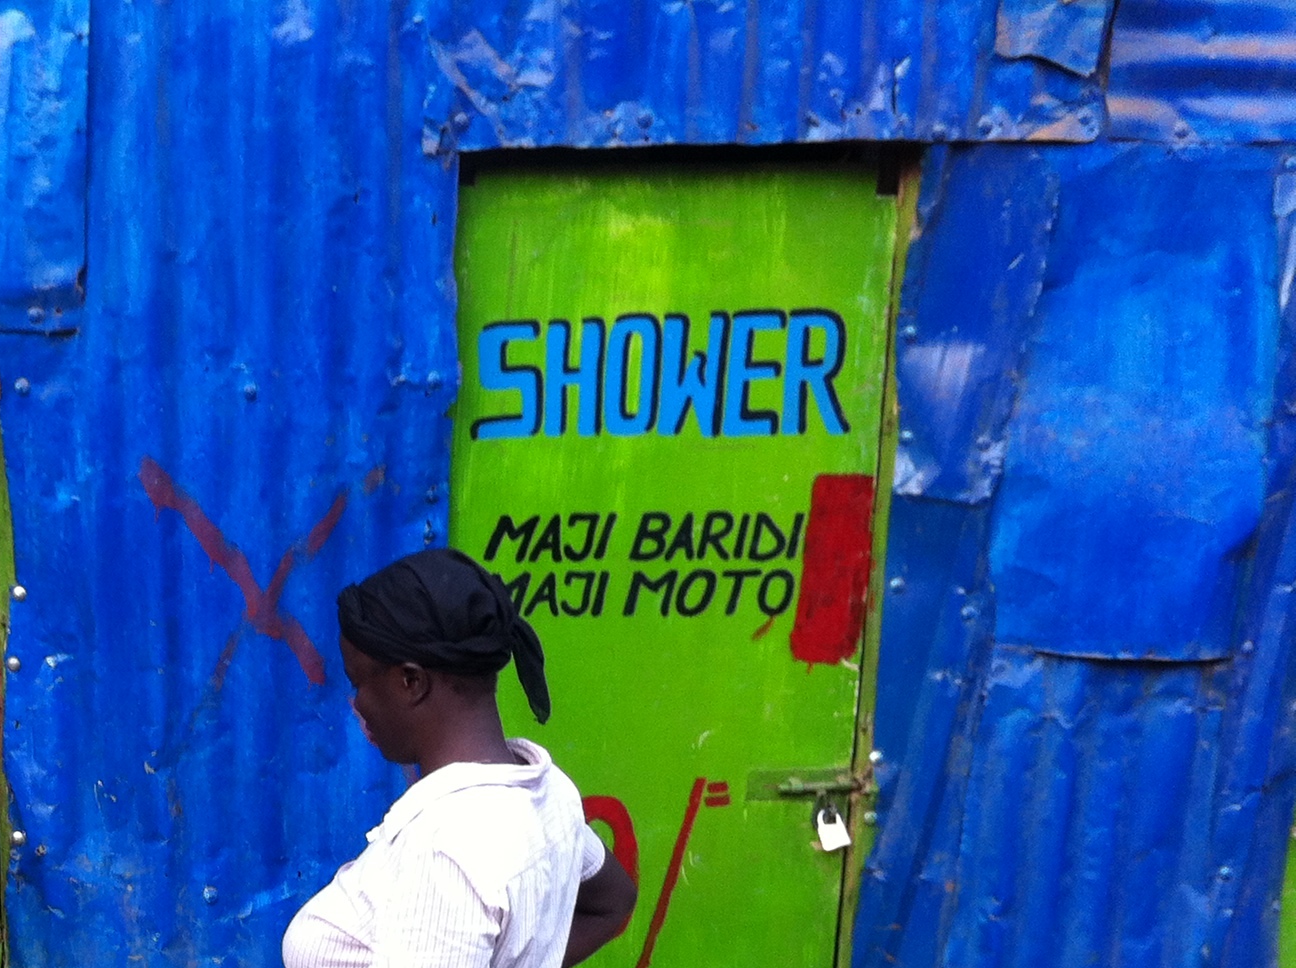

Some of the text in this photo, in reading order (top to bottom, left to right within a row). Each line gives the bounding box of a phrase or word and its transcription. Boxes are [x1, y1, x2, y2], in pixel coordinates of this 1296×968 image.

[470, 307, 851, 440] SHOWER
[483, 510, 805, 563] MAJI BARIDI
[622, 568, 796, 618] MOTO
